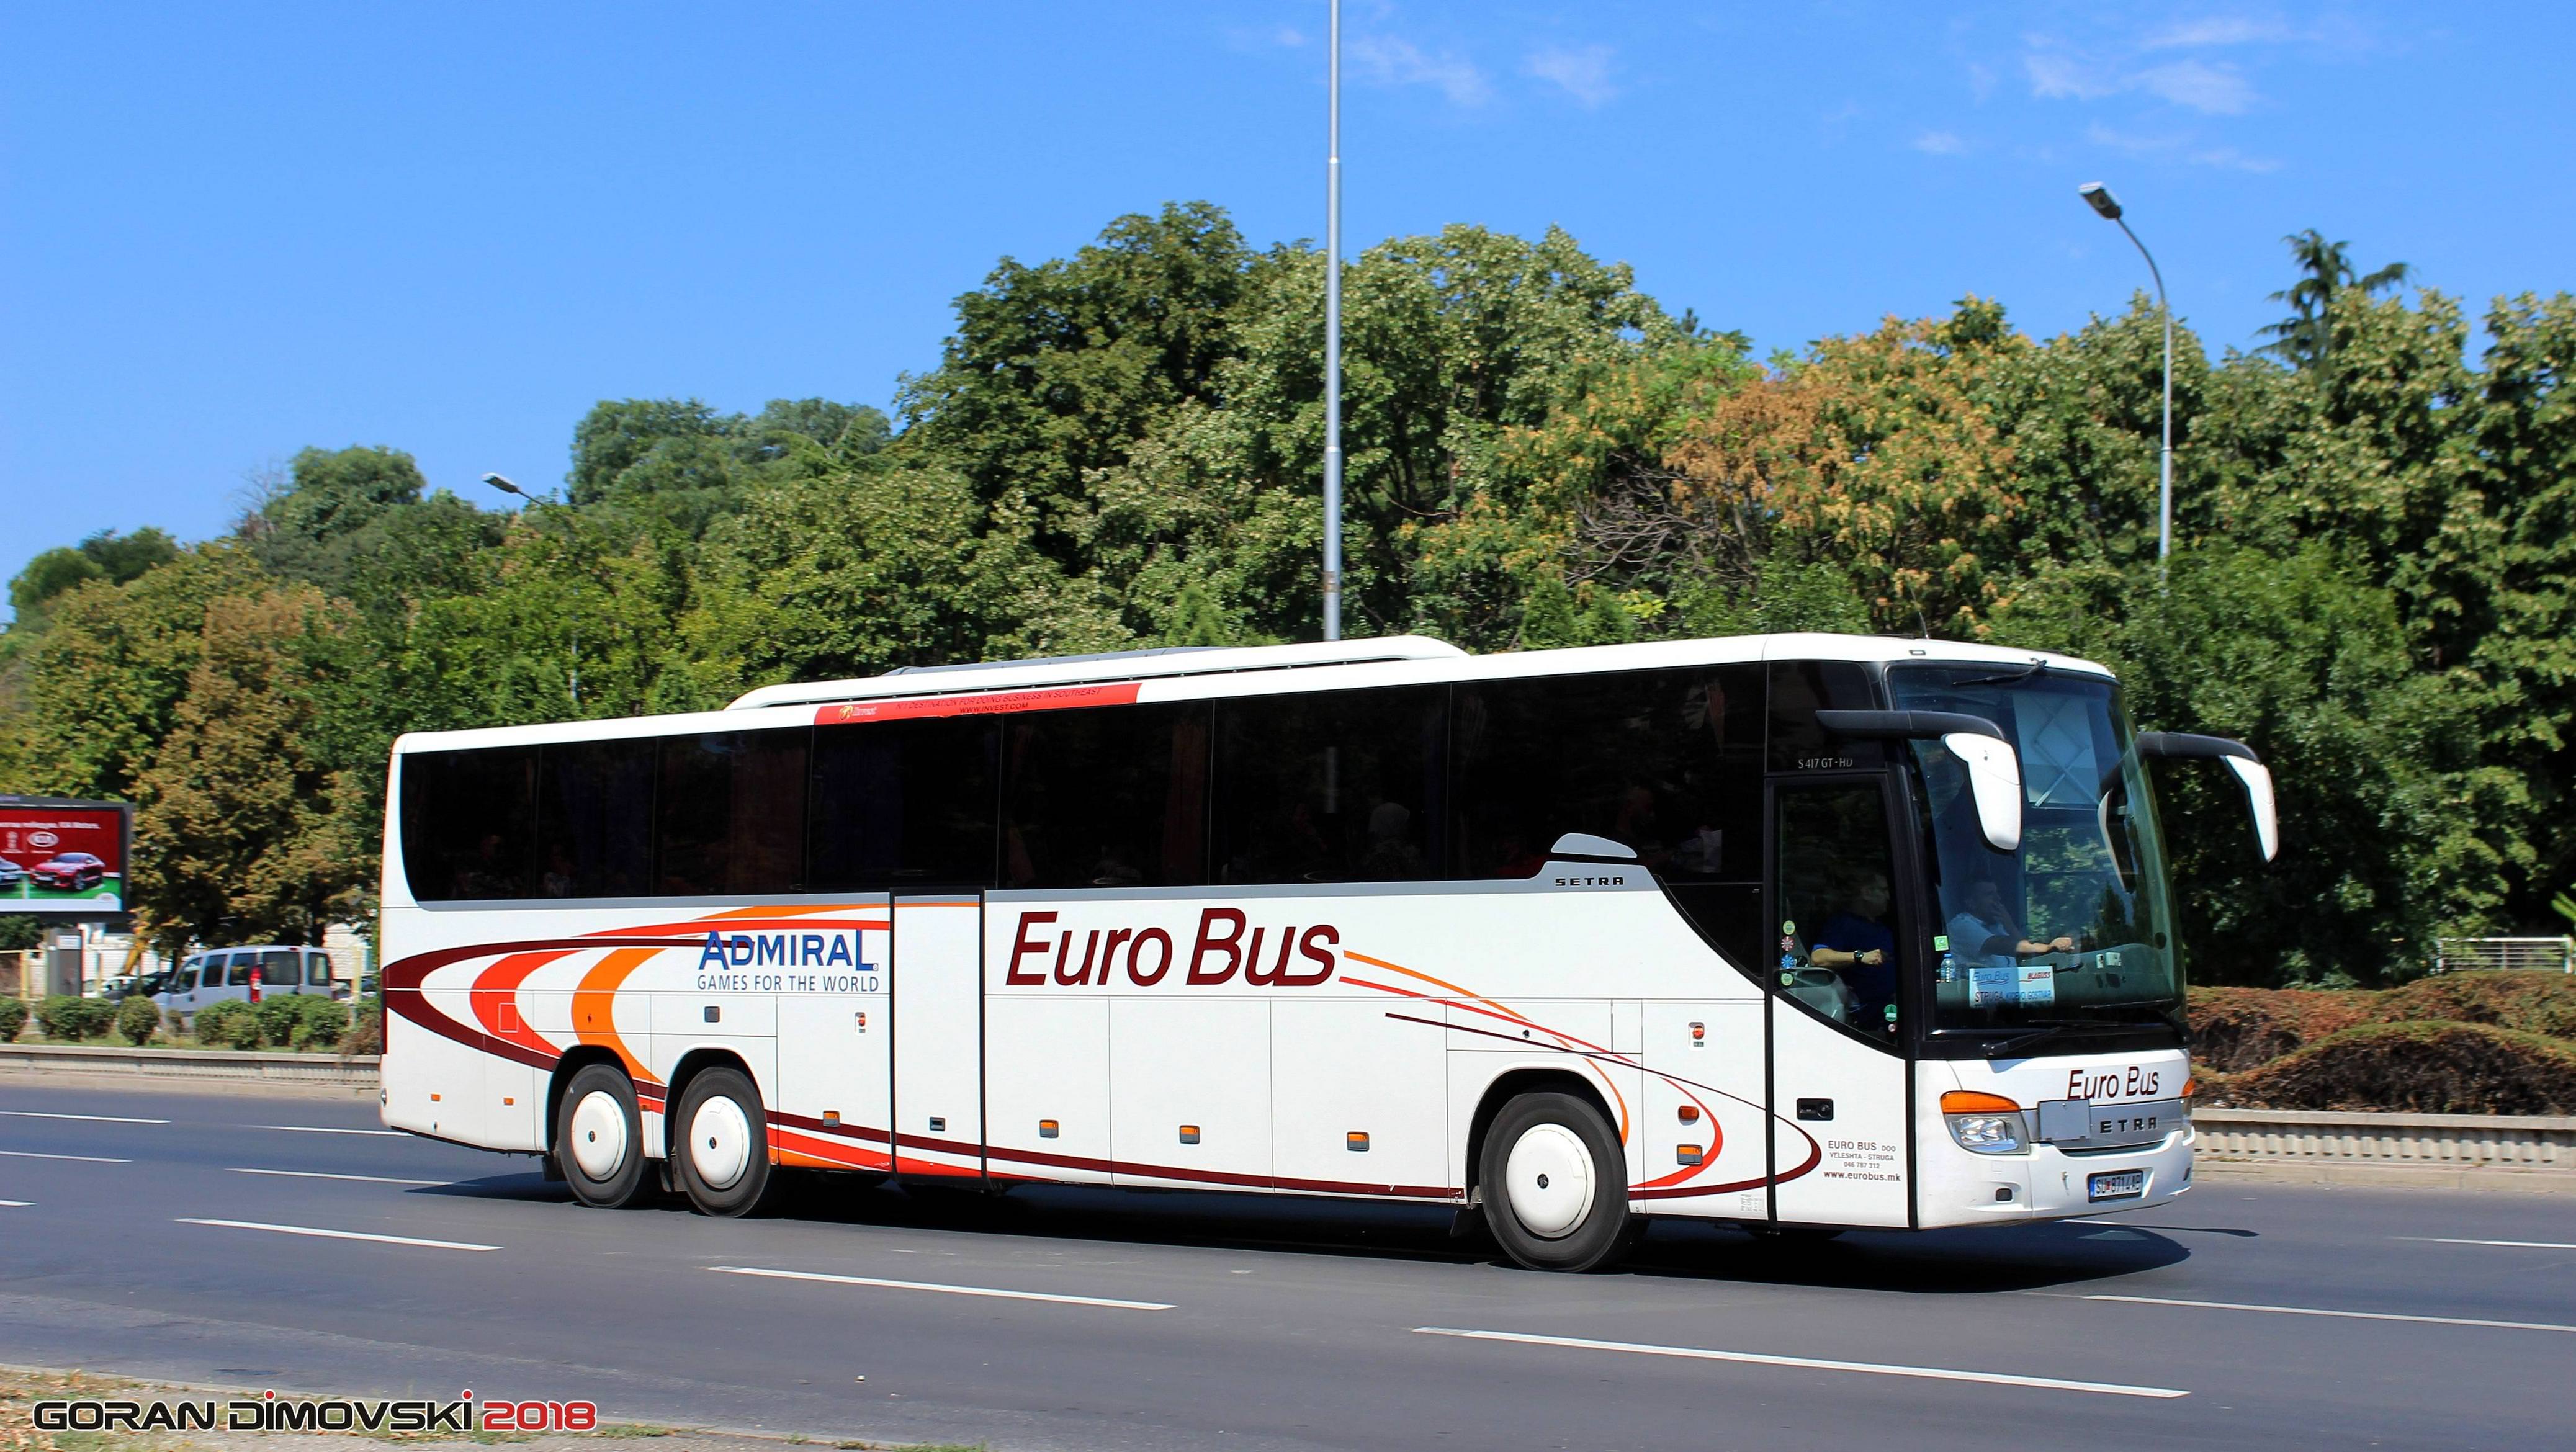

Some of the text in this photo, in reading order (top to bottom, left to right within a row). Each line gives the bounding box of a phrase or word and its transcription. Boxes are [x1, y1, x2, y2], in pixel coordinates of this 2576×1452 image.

[1003, 692, 1042, 702] BUSINESS
[1053, 688, 1103, 698] SOUTHEAST
[1798, 759, 1803, 769] S
[1805, 758, 1820, 768] 417
[1555, 877, 1624, 887] SETRA
[698, 929, 876, 972] ADMIRAL
[1005, 908, 1340, 986] Euro Bus
[697, 974, 879, 992] GAMES FOR THE WORLD
[2067, 1066, 2159, 1100] Euro Bus
[2100, 1117, 2156, 1133] ETRA
[1828, 1141, 1854, 1150] EURO
[1857, 1142, 1877, 1151] BUS
[1823, 1171, 1901, 1181] www.eurobus.mk
